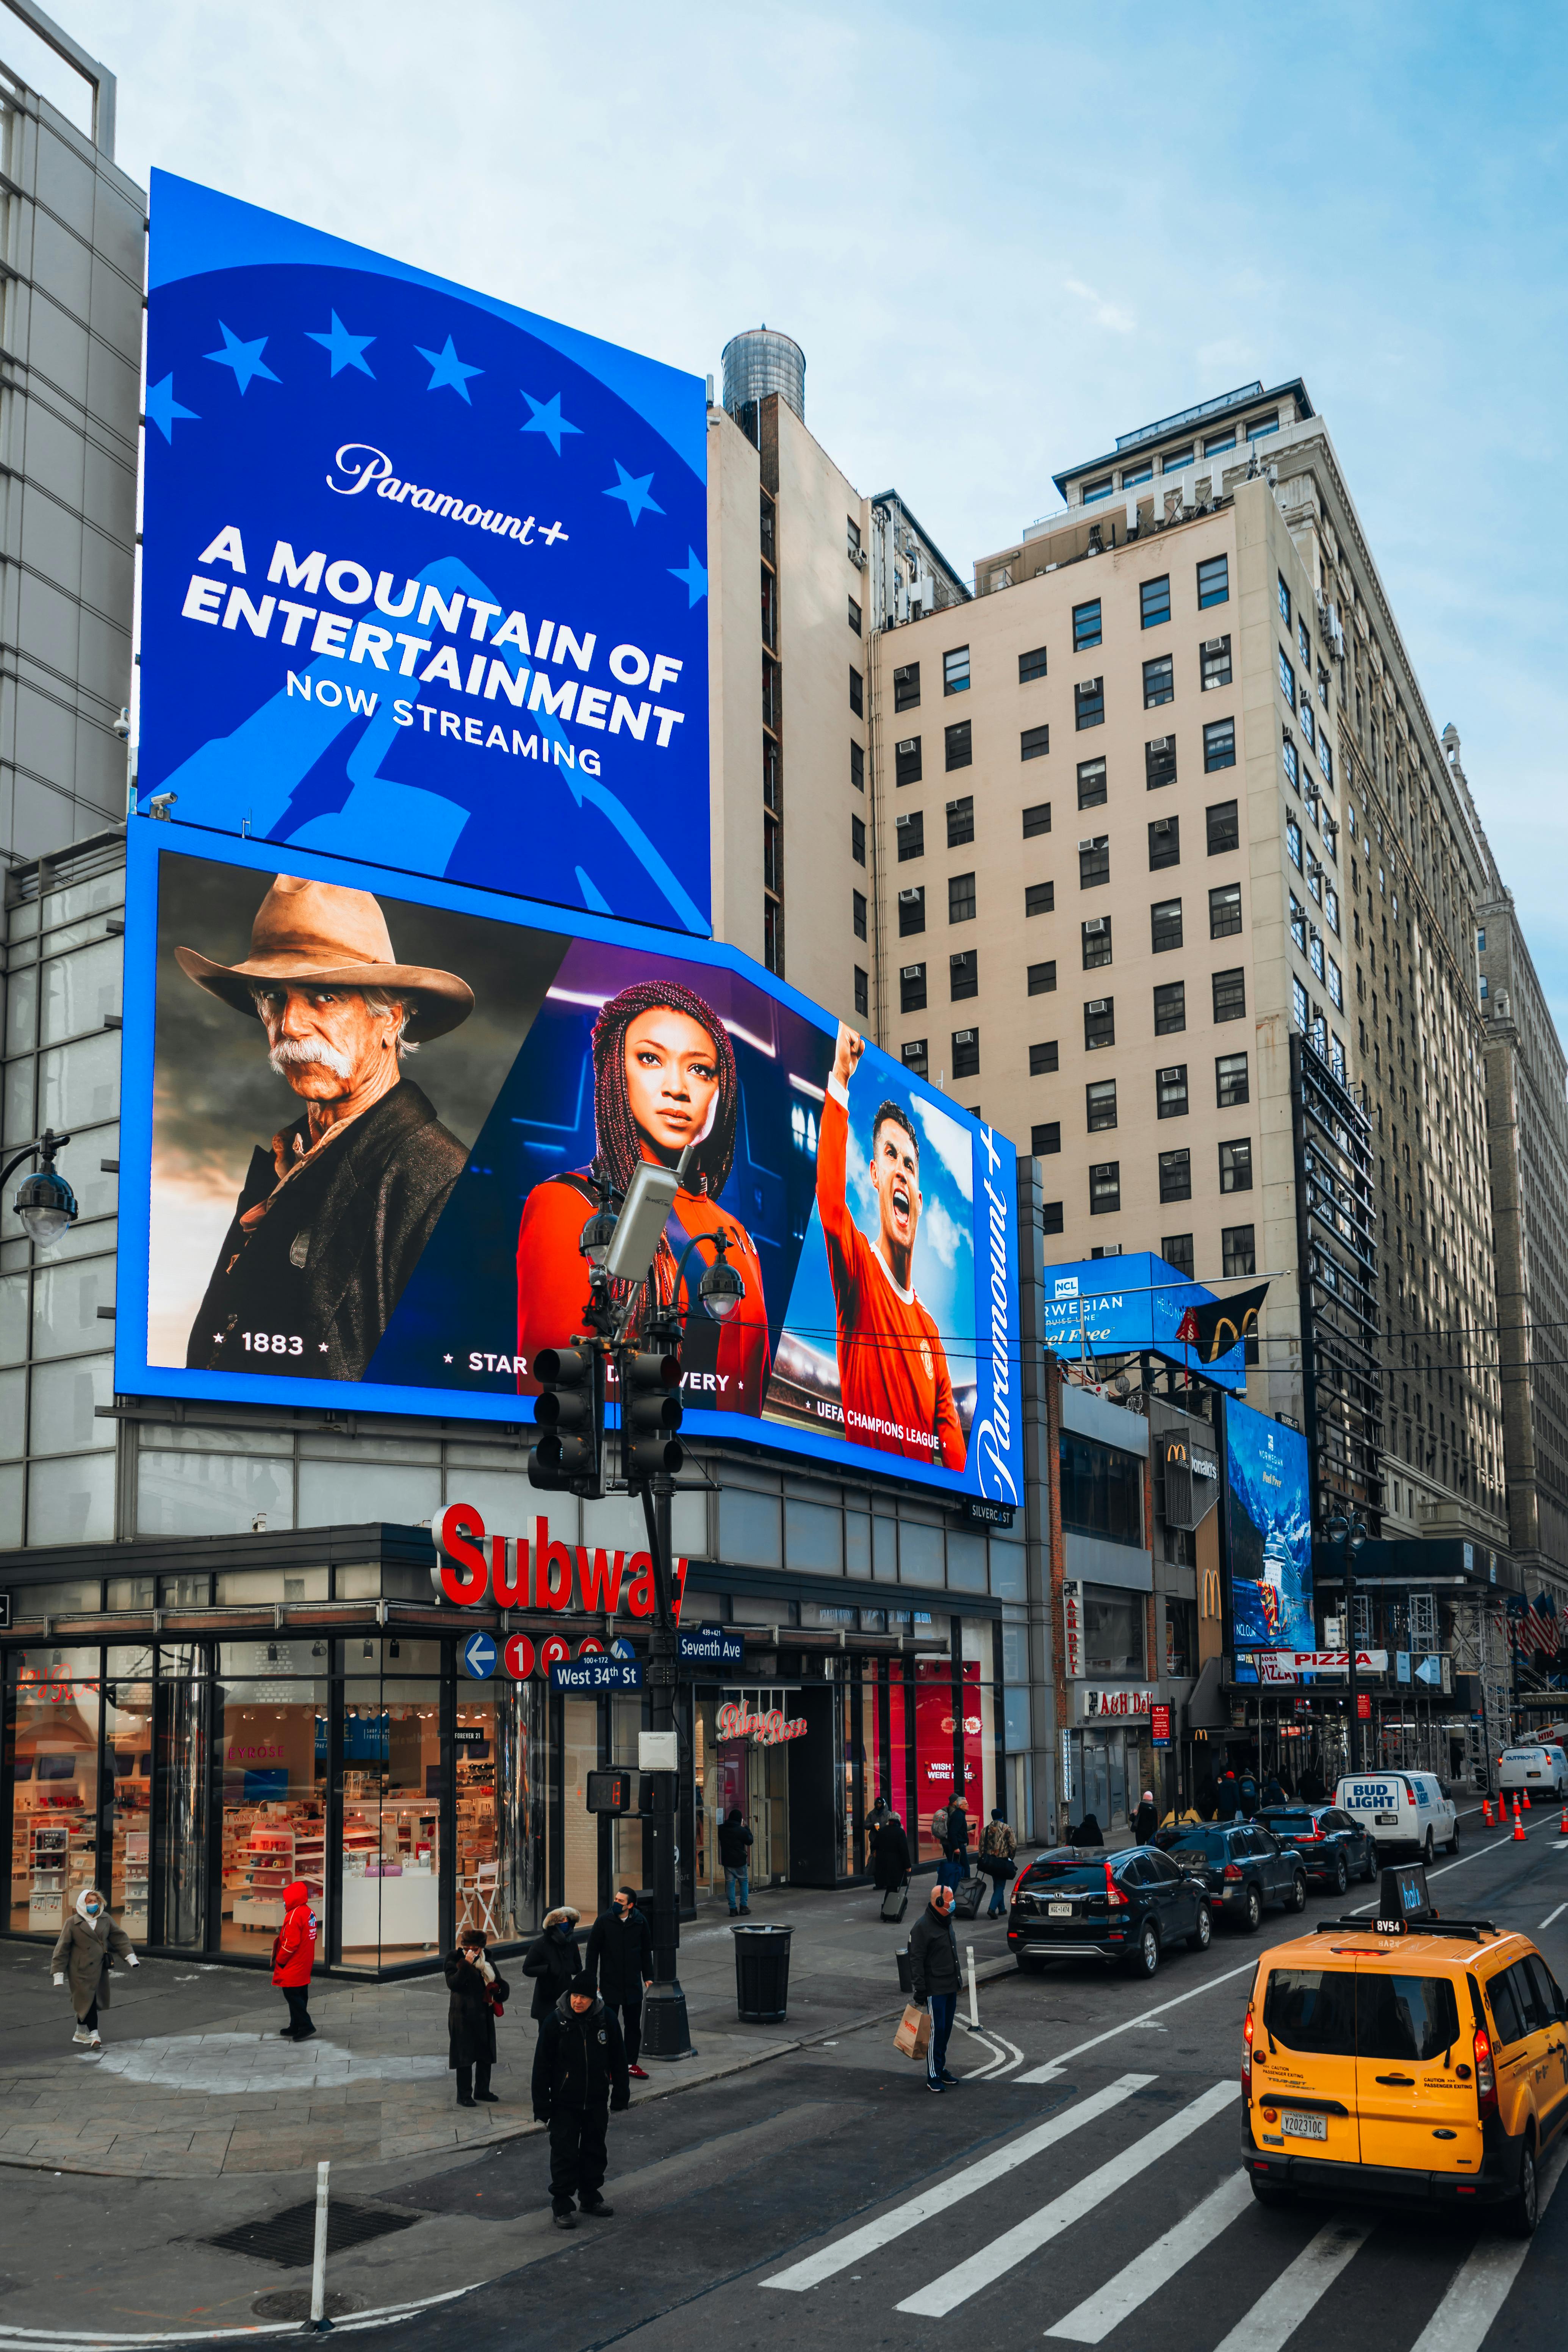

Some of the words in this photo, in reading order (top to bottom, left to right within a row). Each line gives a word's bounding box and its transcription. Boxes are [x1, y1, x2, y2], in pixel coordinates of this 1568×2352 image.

[327, 443, 569, 545] Paramount+
[198, 525, 246, 574] A
[267, 540, 596, 672] MOUNTAIN
[609, 644, 683, 693] OF
[182, 574, 685, 748] ENTERTAINMENT
[286, 670, 378, 716] NOW
[393, 699, 601, 776] STREAMING
[1057, 1282, 1076, 1291] NCL
[1045, 1296, 1122, 1317] RWEGIAN
[1157, 1296, 1173, 1316] HELLO
[242, 1332, 303, 1355] 1883
[469, 1352, 527, 1375] STAR
[817, 1401, 844, 1422] UEFA
[847, 1410, 904, 1440] CHAMPIONS
[906, 1427, 939, 1449] LEAGUE
[682, 1639, 720, 1656] Seventh
[723, 1642, 740, 1657] Ave
[1067, 1633, 1077, 1674] DELI
[1295, 1653, 1372, 1666] PIZZA
[557, 1669, 590, 1685] West
[595, 1667, 618, 1684] 34th
[623, 1667, 636, 1684] St
[1101, 1693, 1128, 1714] A&H
[717, 1699, 766, 1743] Riley
[764, 1709, 807, 1746] Rose
[1538, 1730, 1554, 1741] H110
[1354, 1784, 1388, 1796] BUD
[1347, 1796, 1395, 1808] LIGHT
[233, 1813, 255, 1822] WINKY
[1377, 1920, 1400, 1932] 8V54
